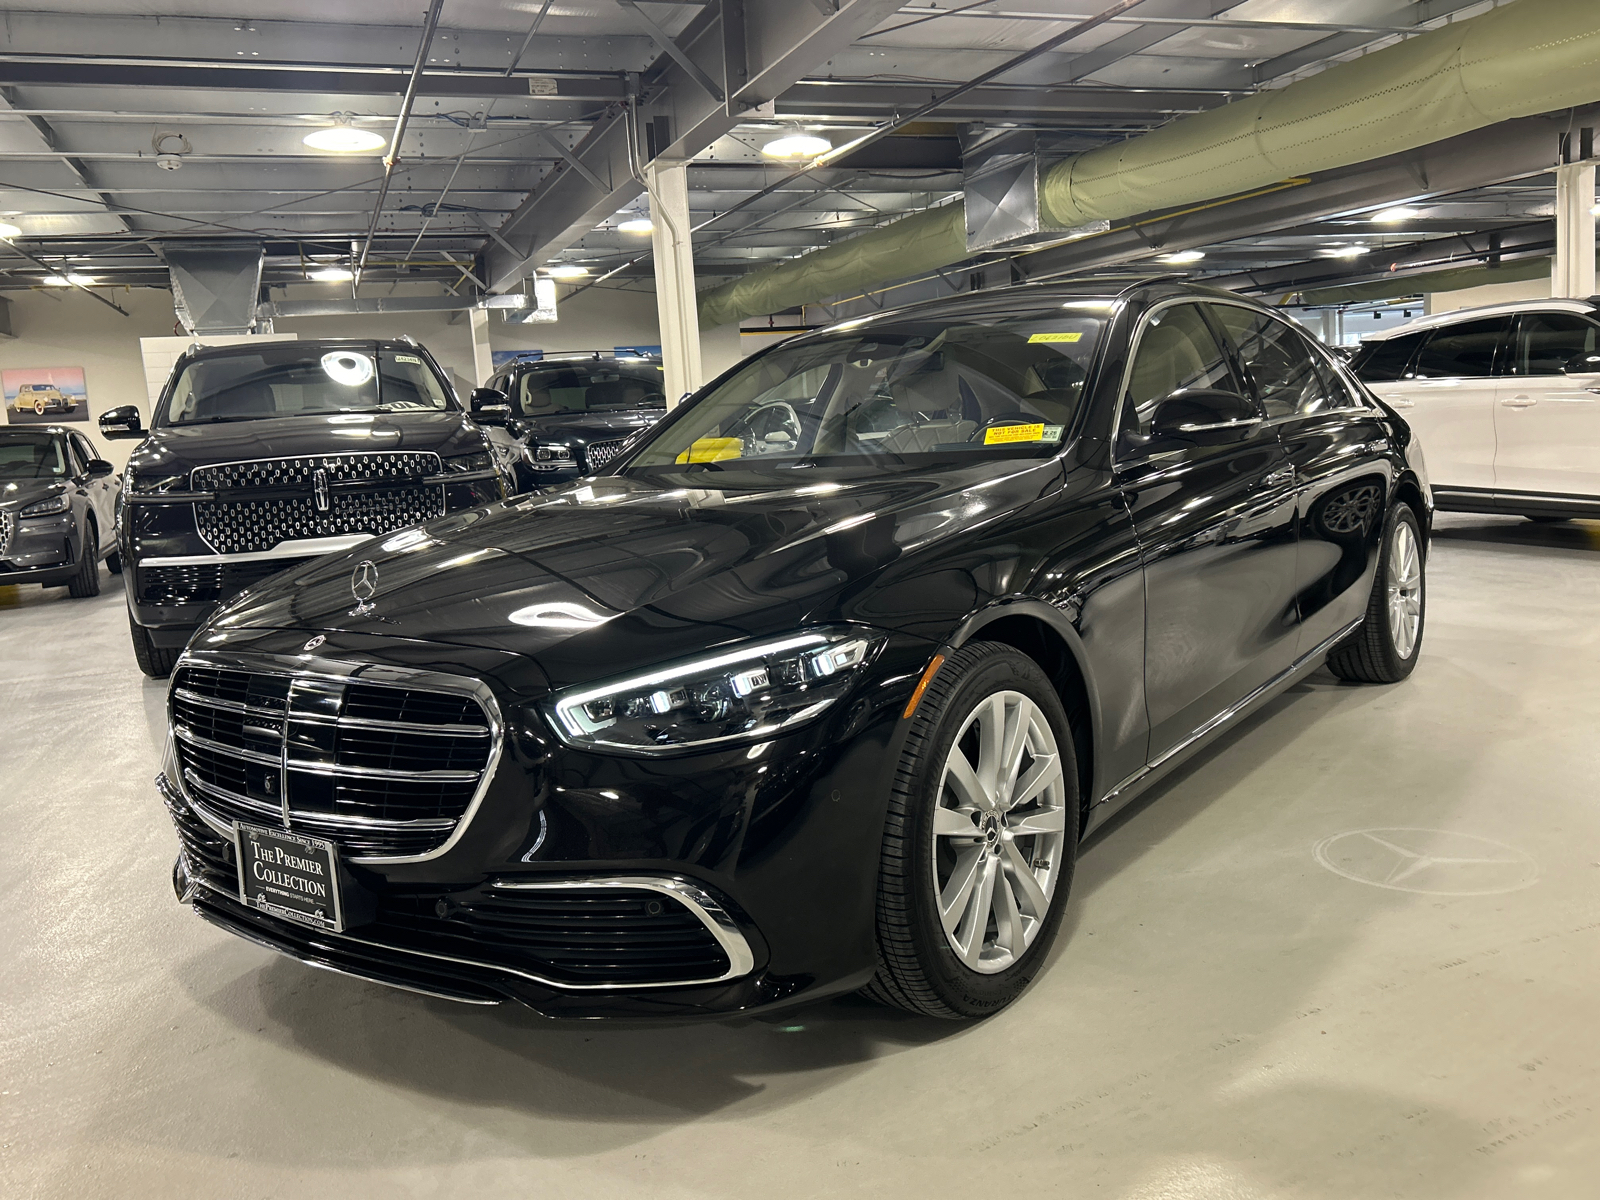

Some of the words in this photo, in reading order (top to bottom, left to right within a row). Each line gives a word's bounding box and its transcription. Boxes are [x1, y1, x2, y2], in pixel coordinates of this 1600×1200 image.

[268, 829, 295, 840] EXCELLENCE
[297, 836, 311, 845] SINCE
[312, 839, 325, 849] 1995
[250, 840, 275, 863] THE
[274, 846, 324, 876] PREMIER
[253, 860, 326, 898] COLLECTION
[265, 886, 290, 897] EVERYTHING
[290, 893, 304, 902] STARTS
[963, 994, 1012, 1008] TURANZA
